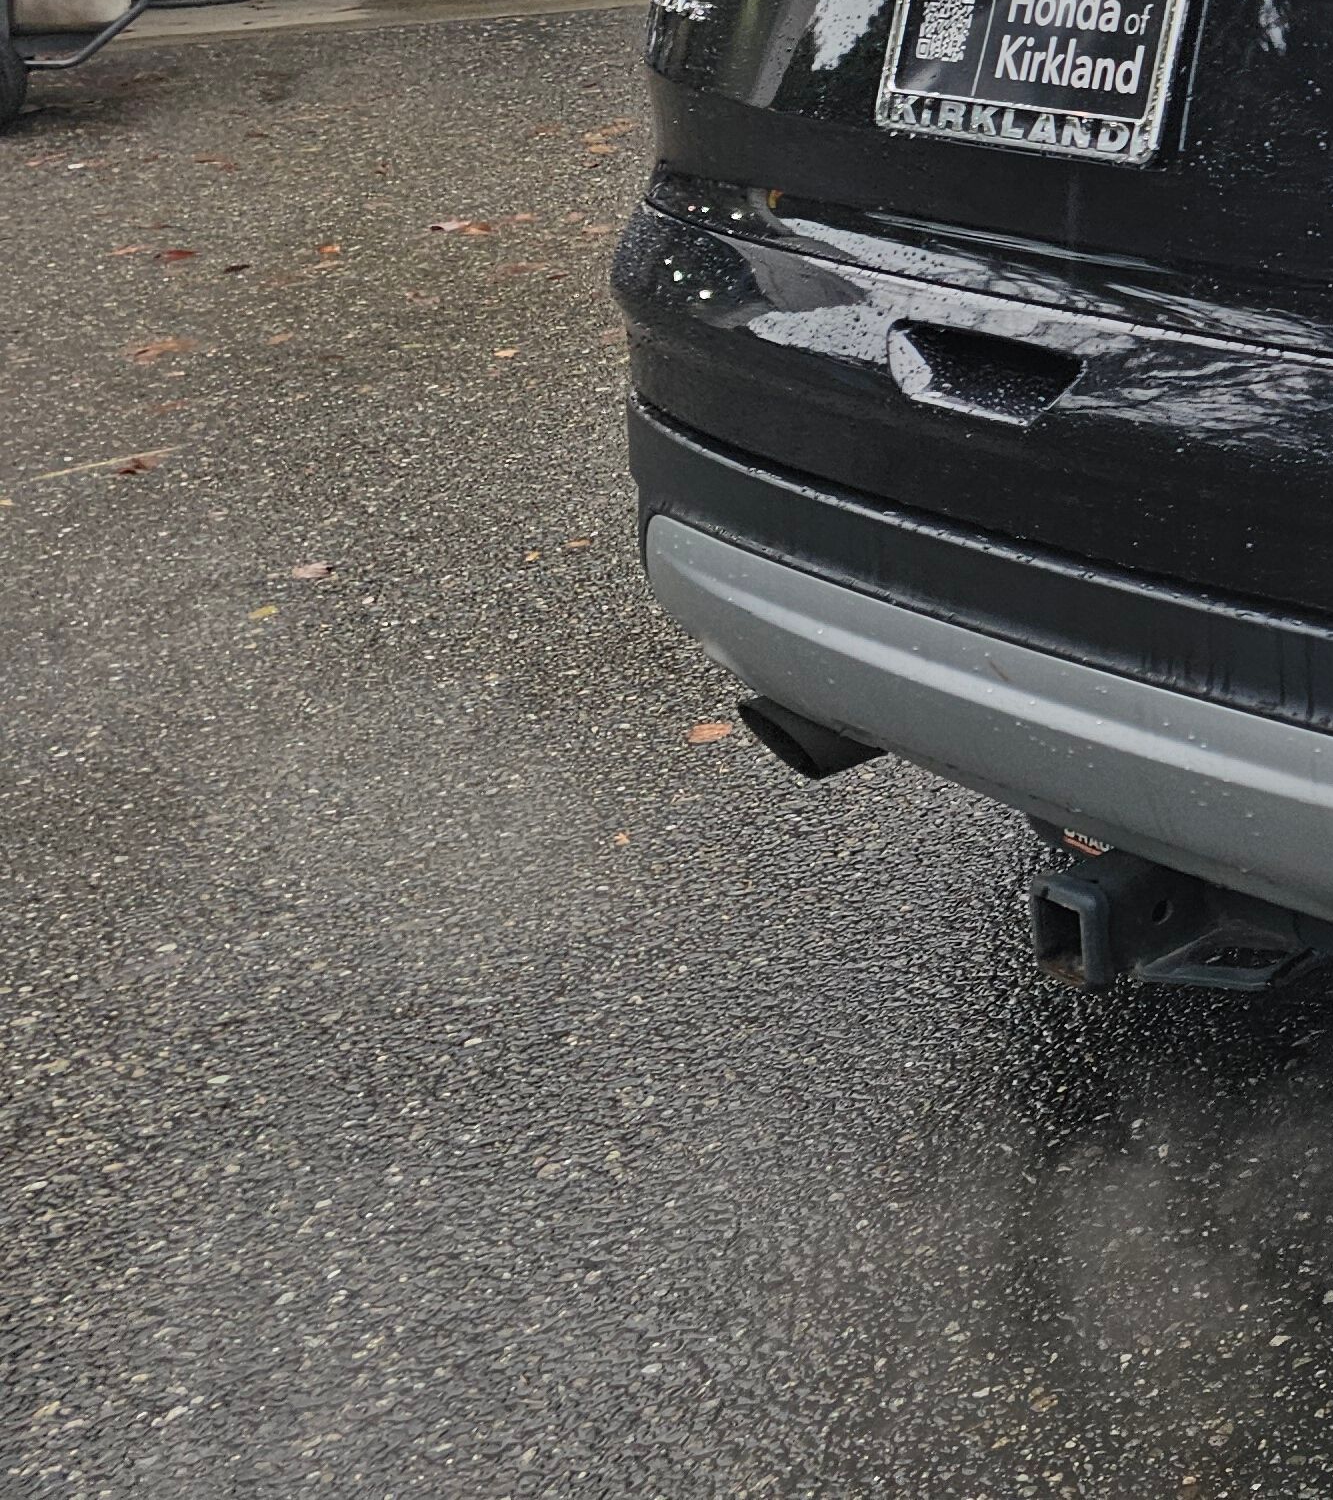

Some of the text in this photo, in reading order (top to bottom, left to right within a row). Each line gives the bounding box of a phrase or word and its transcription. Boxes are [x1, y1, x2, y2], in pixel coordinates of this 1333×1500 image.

[1123, 3, 1155, 36] of
[994, 34, 1146, 95] Kirkland
[889, 94, 1132, 153] KIRKLAND
